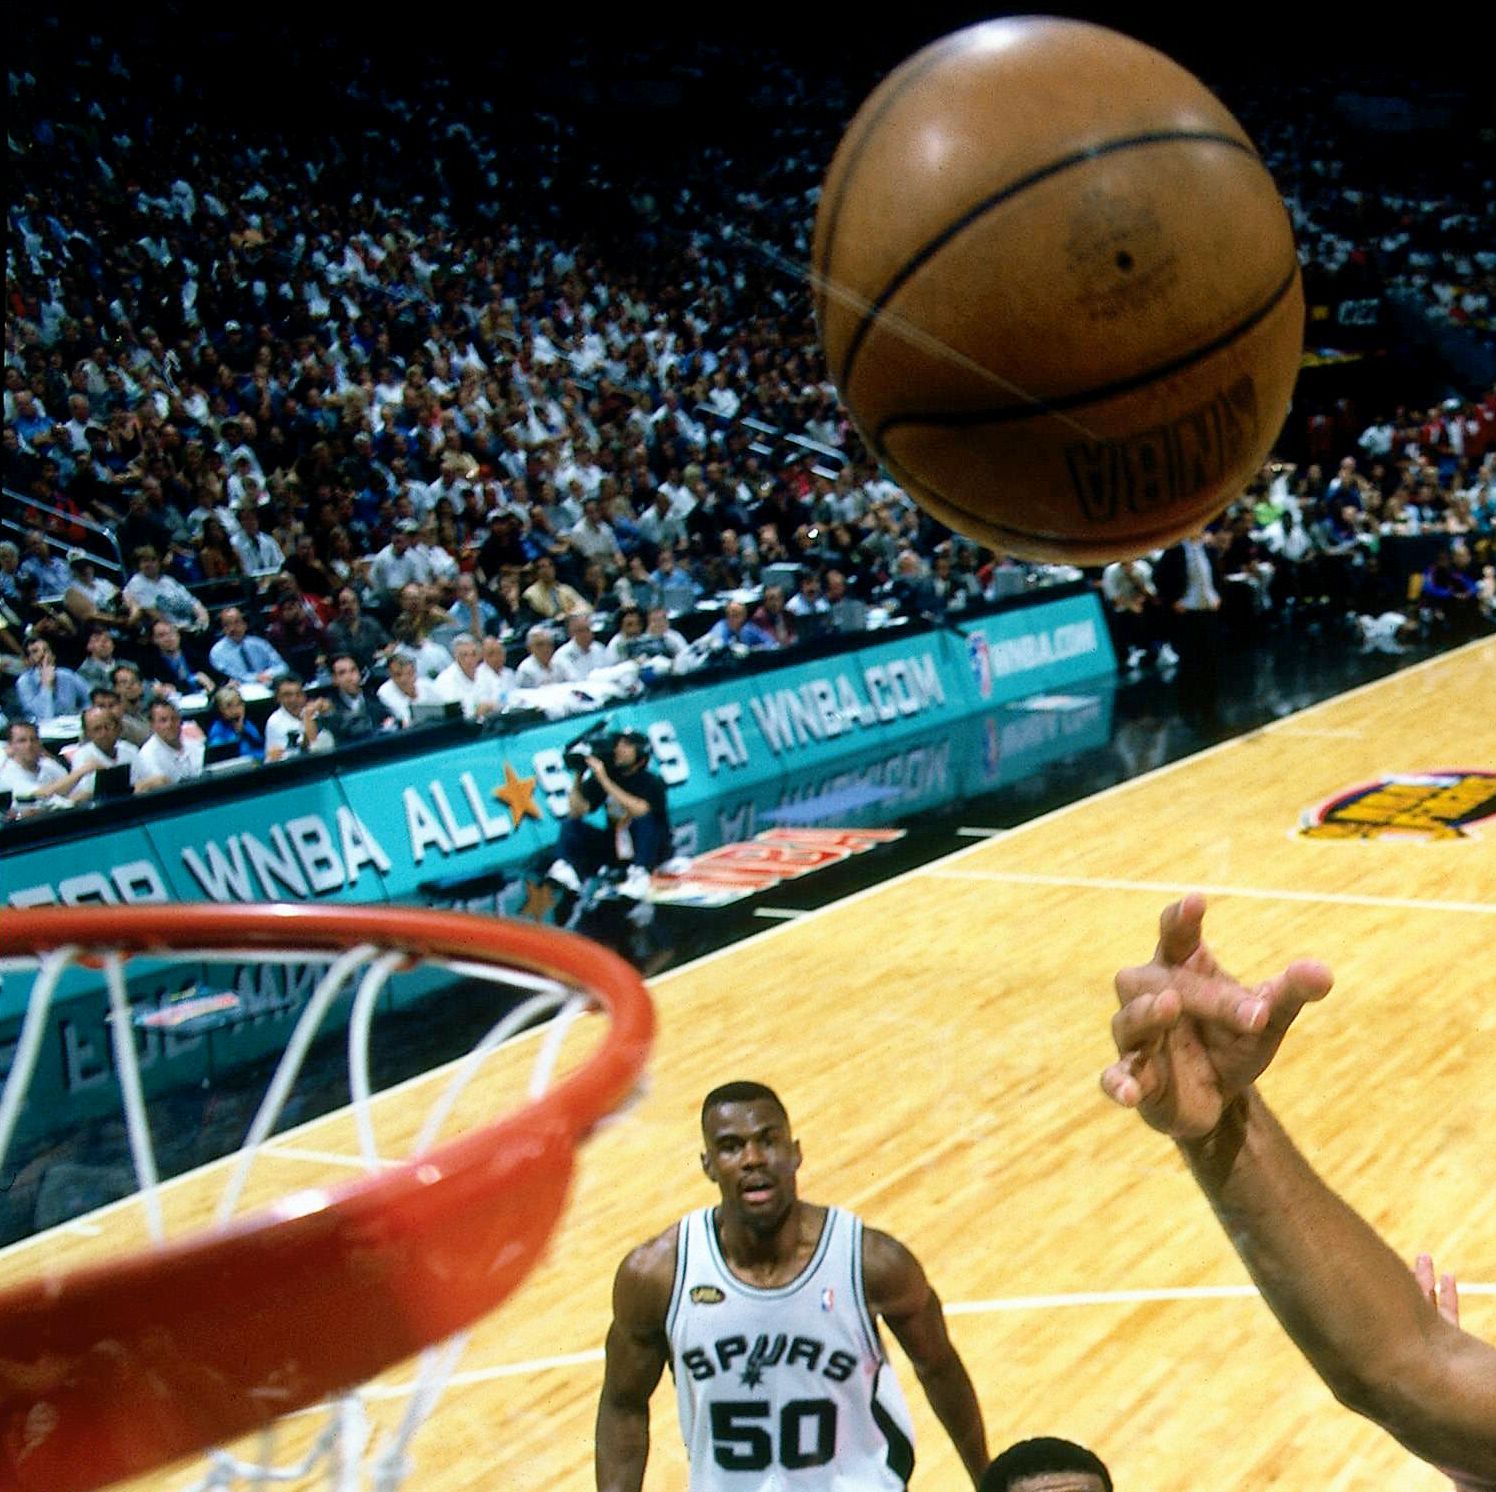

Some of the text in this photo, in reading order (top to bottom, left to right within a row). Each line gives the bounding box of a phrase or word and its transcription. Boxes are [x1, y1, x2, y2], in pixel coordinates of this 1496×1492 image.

[701, 703, 751, 776] AT
[751, 655, 946, 755] WNBA.COM
[182, 806, 391, 901] WNBA
[404, 772, 511, 861] ALL
[682, 1333, 858, 1391] SPURS
[709, 1398, 838, 1471] 50
